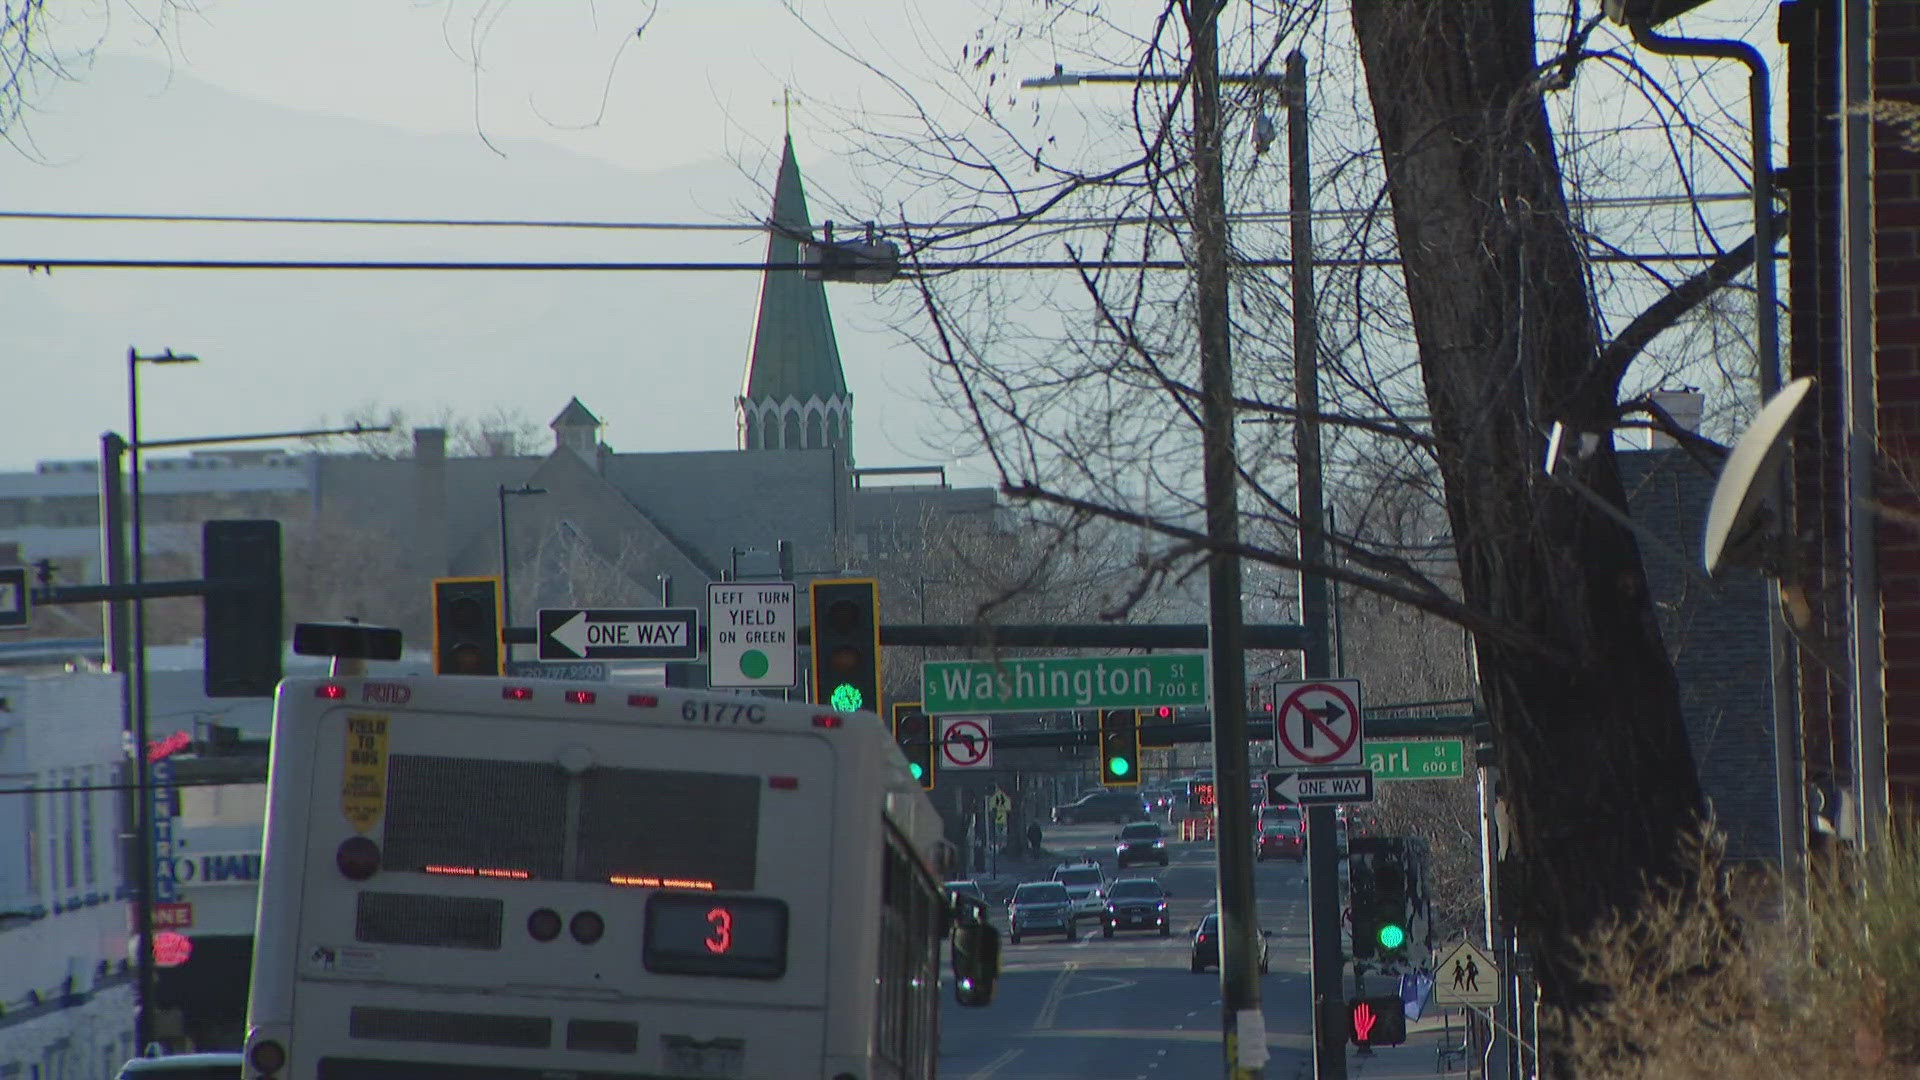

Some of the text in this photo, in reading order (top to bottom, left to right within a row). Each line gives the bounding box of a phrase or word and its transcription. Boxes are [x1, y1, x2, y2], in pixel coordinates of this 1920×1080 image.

[714, 592, 790, 605] LEFT TURN
[729, 610, 776, 626] YIELD
[587, 624, 680, 644] ONE WAY
[719, 631, 786, 644] ON GREEN
[1171, 663, 1185, 677] St
[929, 662, 1151, 704] S Washington
[1158, 682, 1199, 697] 700 E
[682, 700, 765, 724] 6177C
[347, 718, 386, 734] YIELD
[1369, 747, 1445, 773] arl St
[1422, 763, 1458, 773] 600 E
[1299, 780, 1361, 795] ONE WAY
[154, 762, 173, 898] CENTRAL
[706, 907, 732, 953] 3
